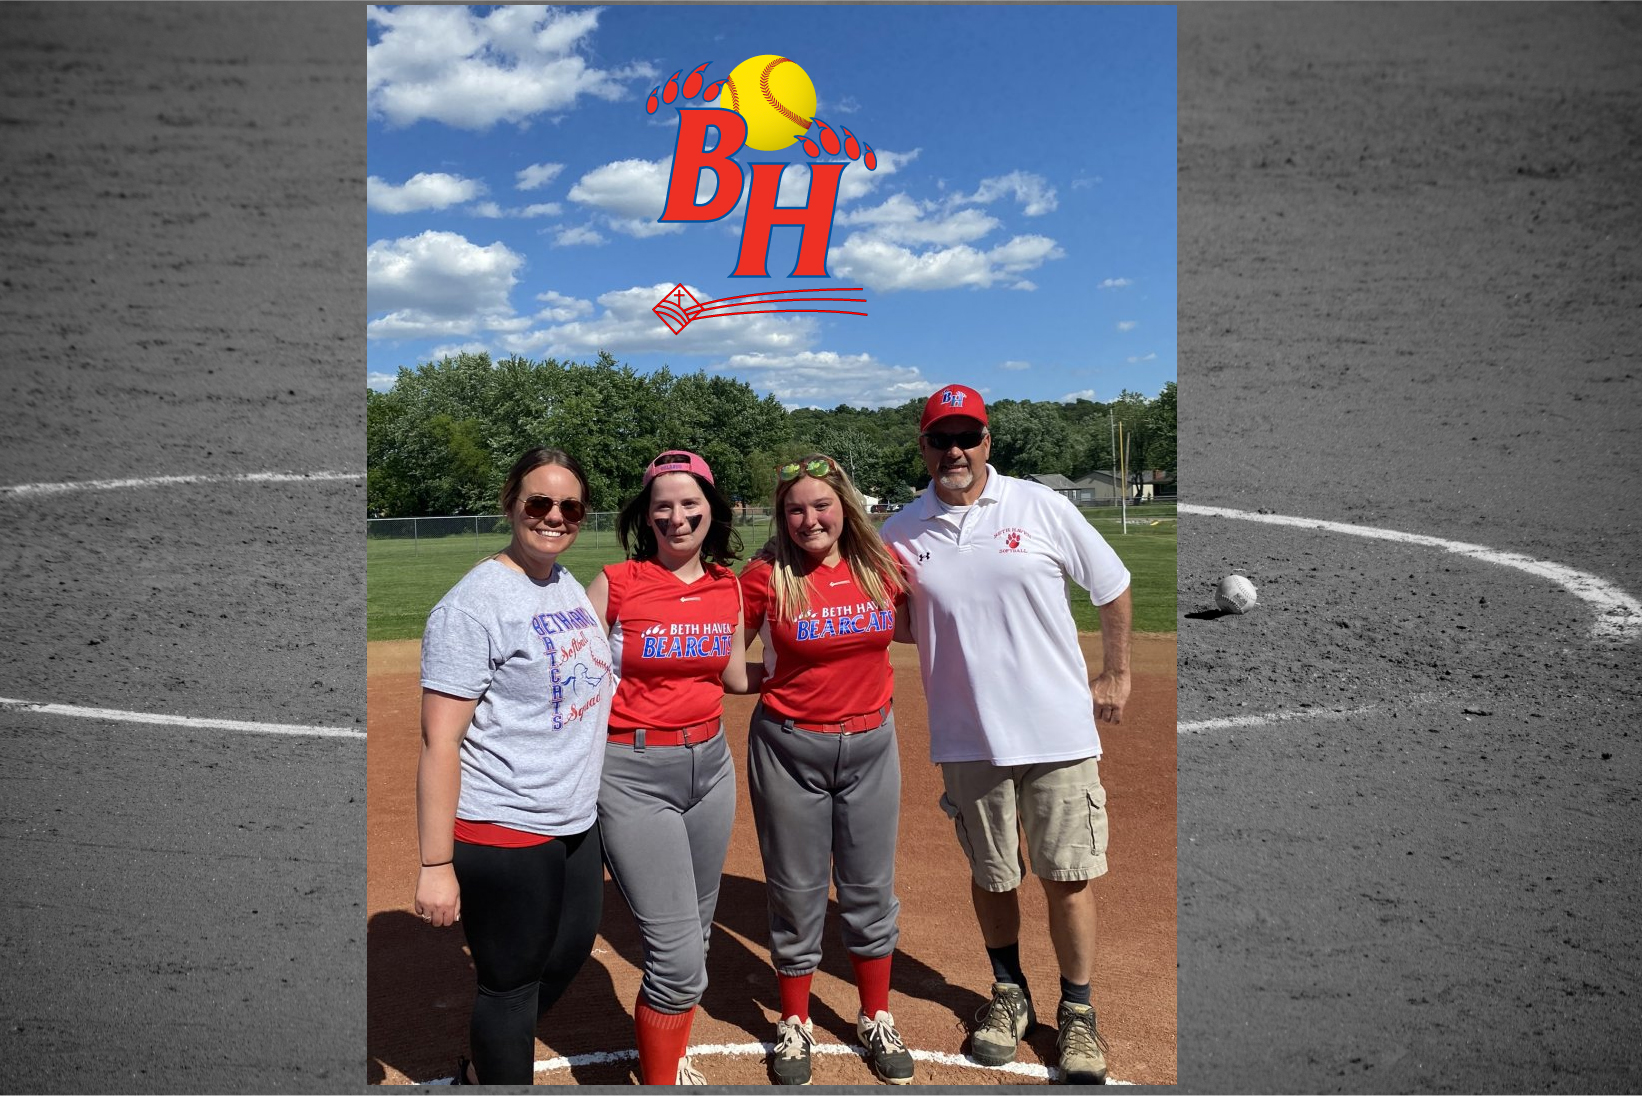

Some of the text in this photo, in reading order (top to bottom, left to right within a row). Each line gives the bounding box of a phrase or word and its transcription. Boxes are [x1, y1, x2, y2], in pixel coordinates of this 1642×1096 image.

[941, 389, 965, 408] BH
[822, 599, 889, 617] BETH HAV
[670, 623, 699, 635] BETH
[796, 609, 894, 641] BEARCATS
[642, 635, 731, 658] BEARCATS
